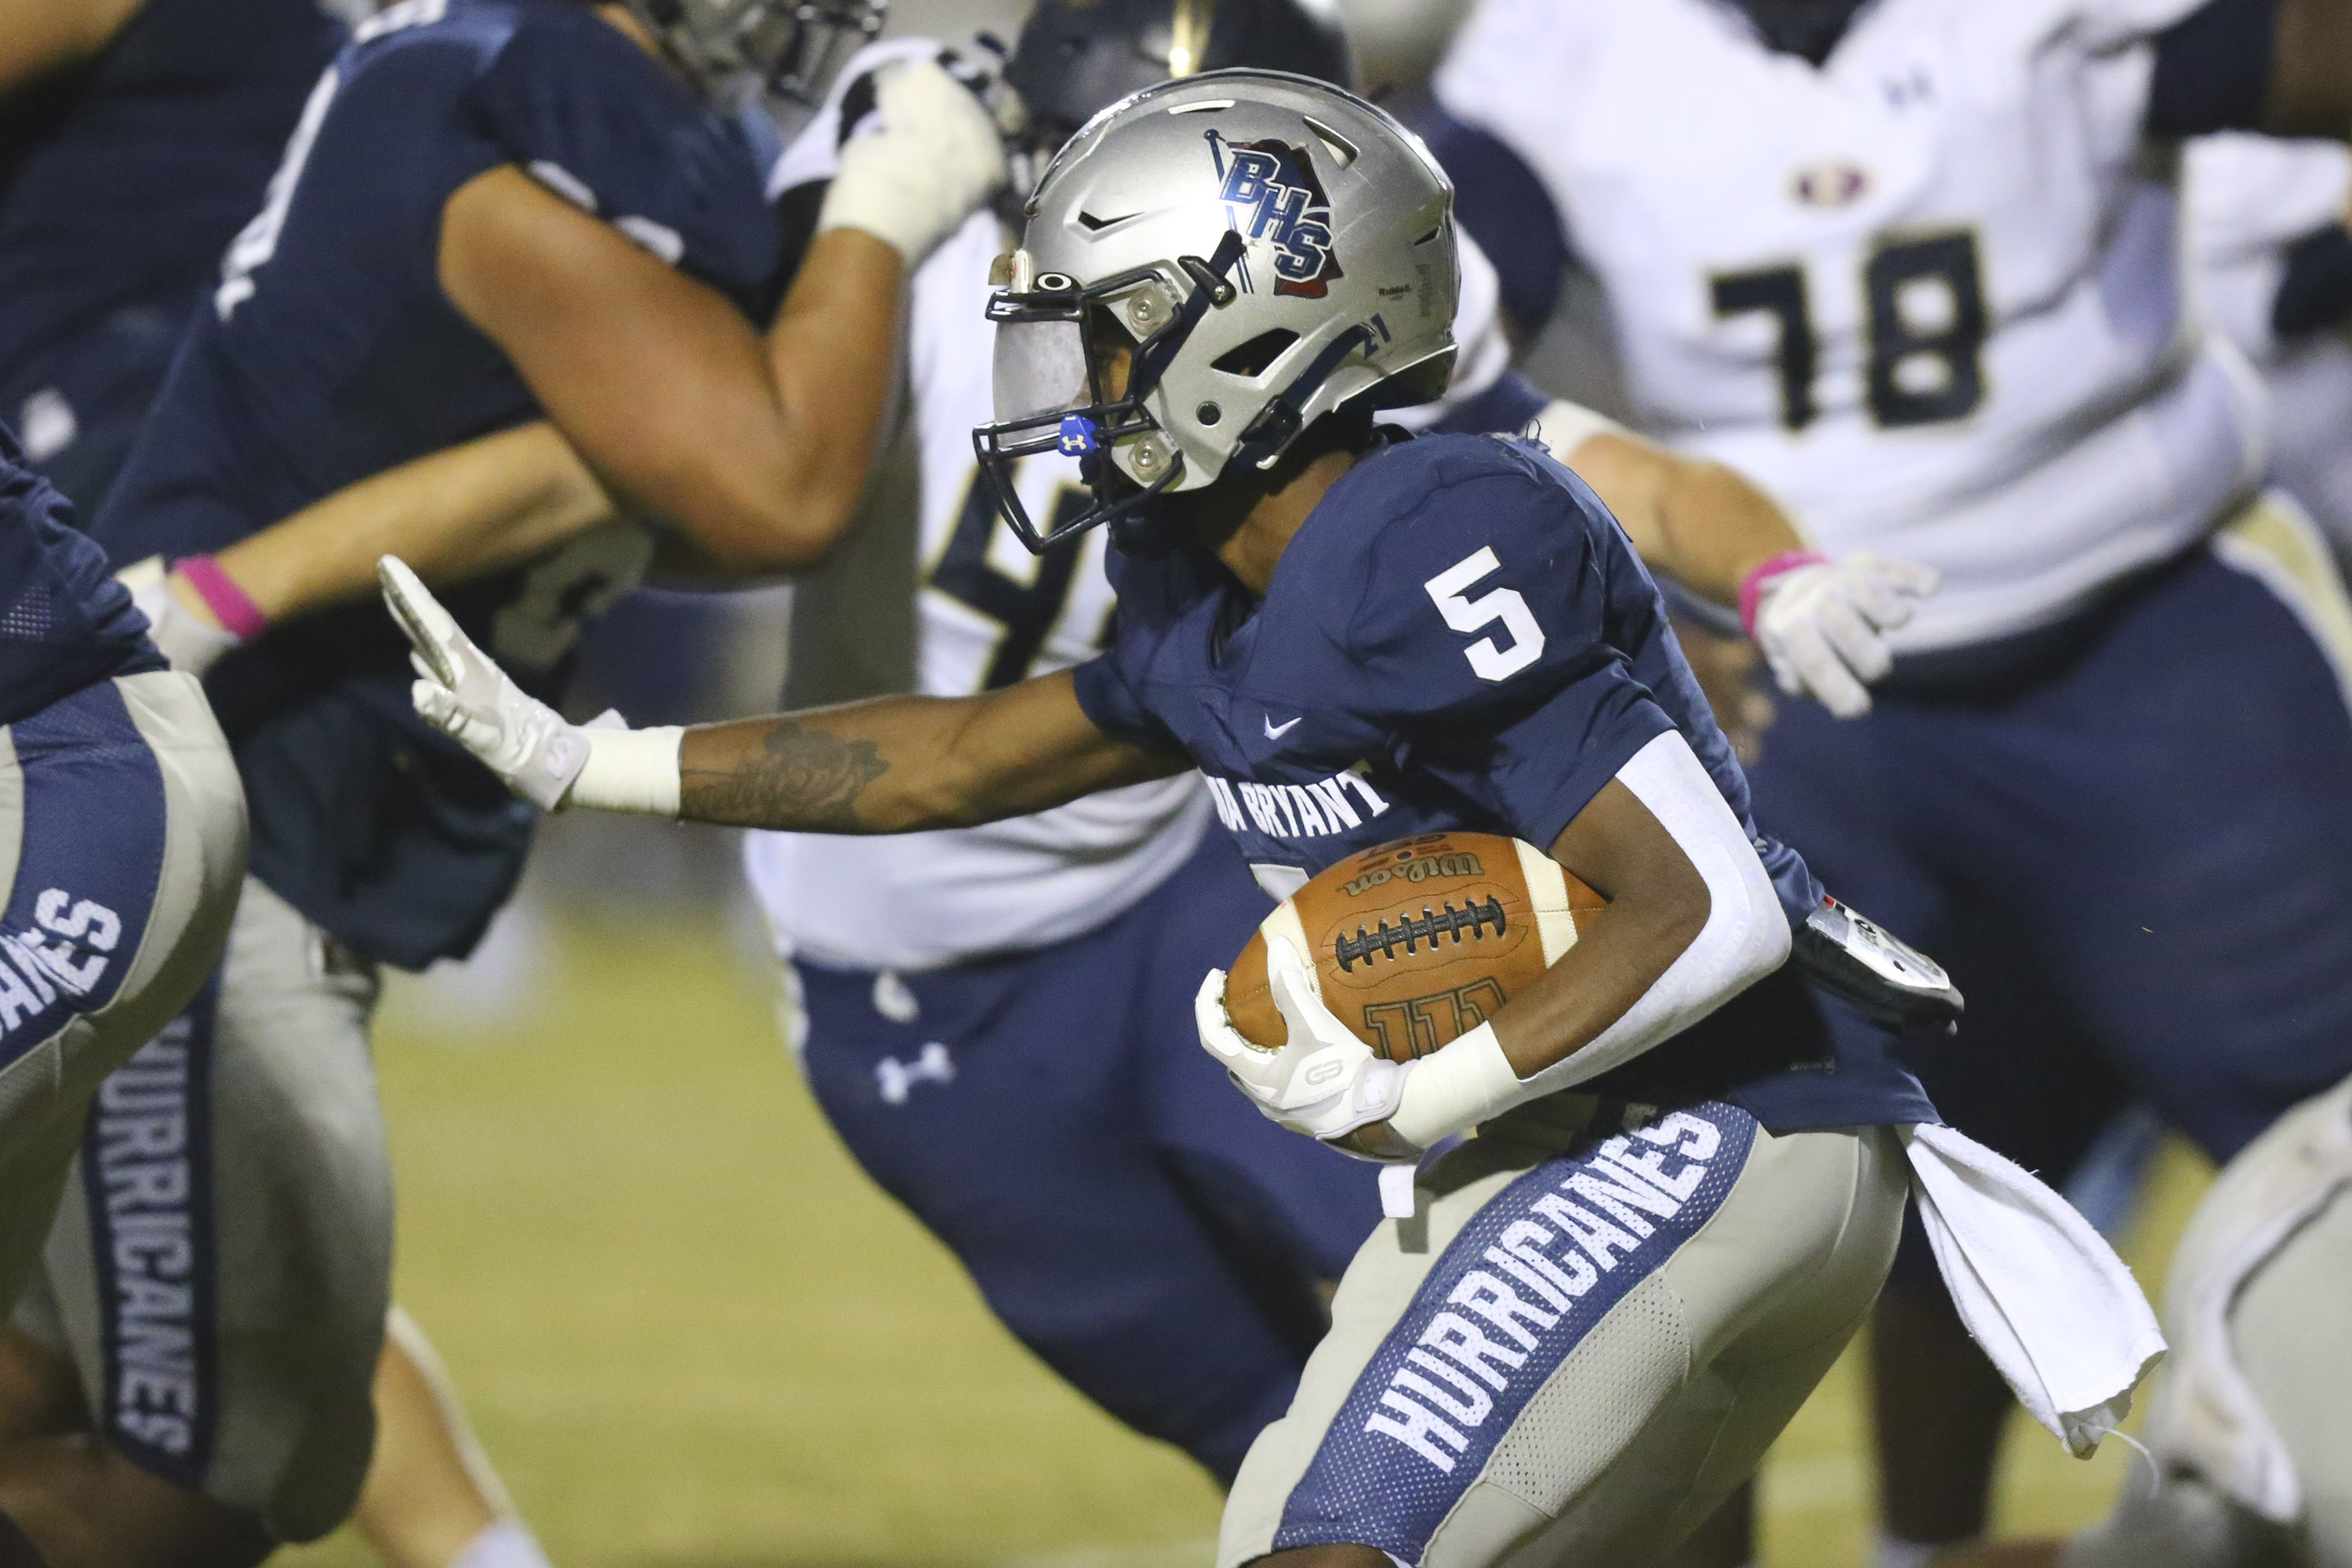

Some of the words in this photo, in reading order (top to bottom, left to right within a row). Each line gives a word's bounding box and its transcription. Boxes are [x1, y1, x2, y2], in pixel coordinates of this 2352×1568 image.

[1220, 147, 1334, 283] BHS
[1704, 223, 1987, 433] 78
[1424, 546, 1545, 682] 5
[1238, 768, 1389, 837] BRYANT
[1343, 851, 1484, 897] Wilson
[1363, 1111, 1722, 1474] HURRICANES
